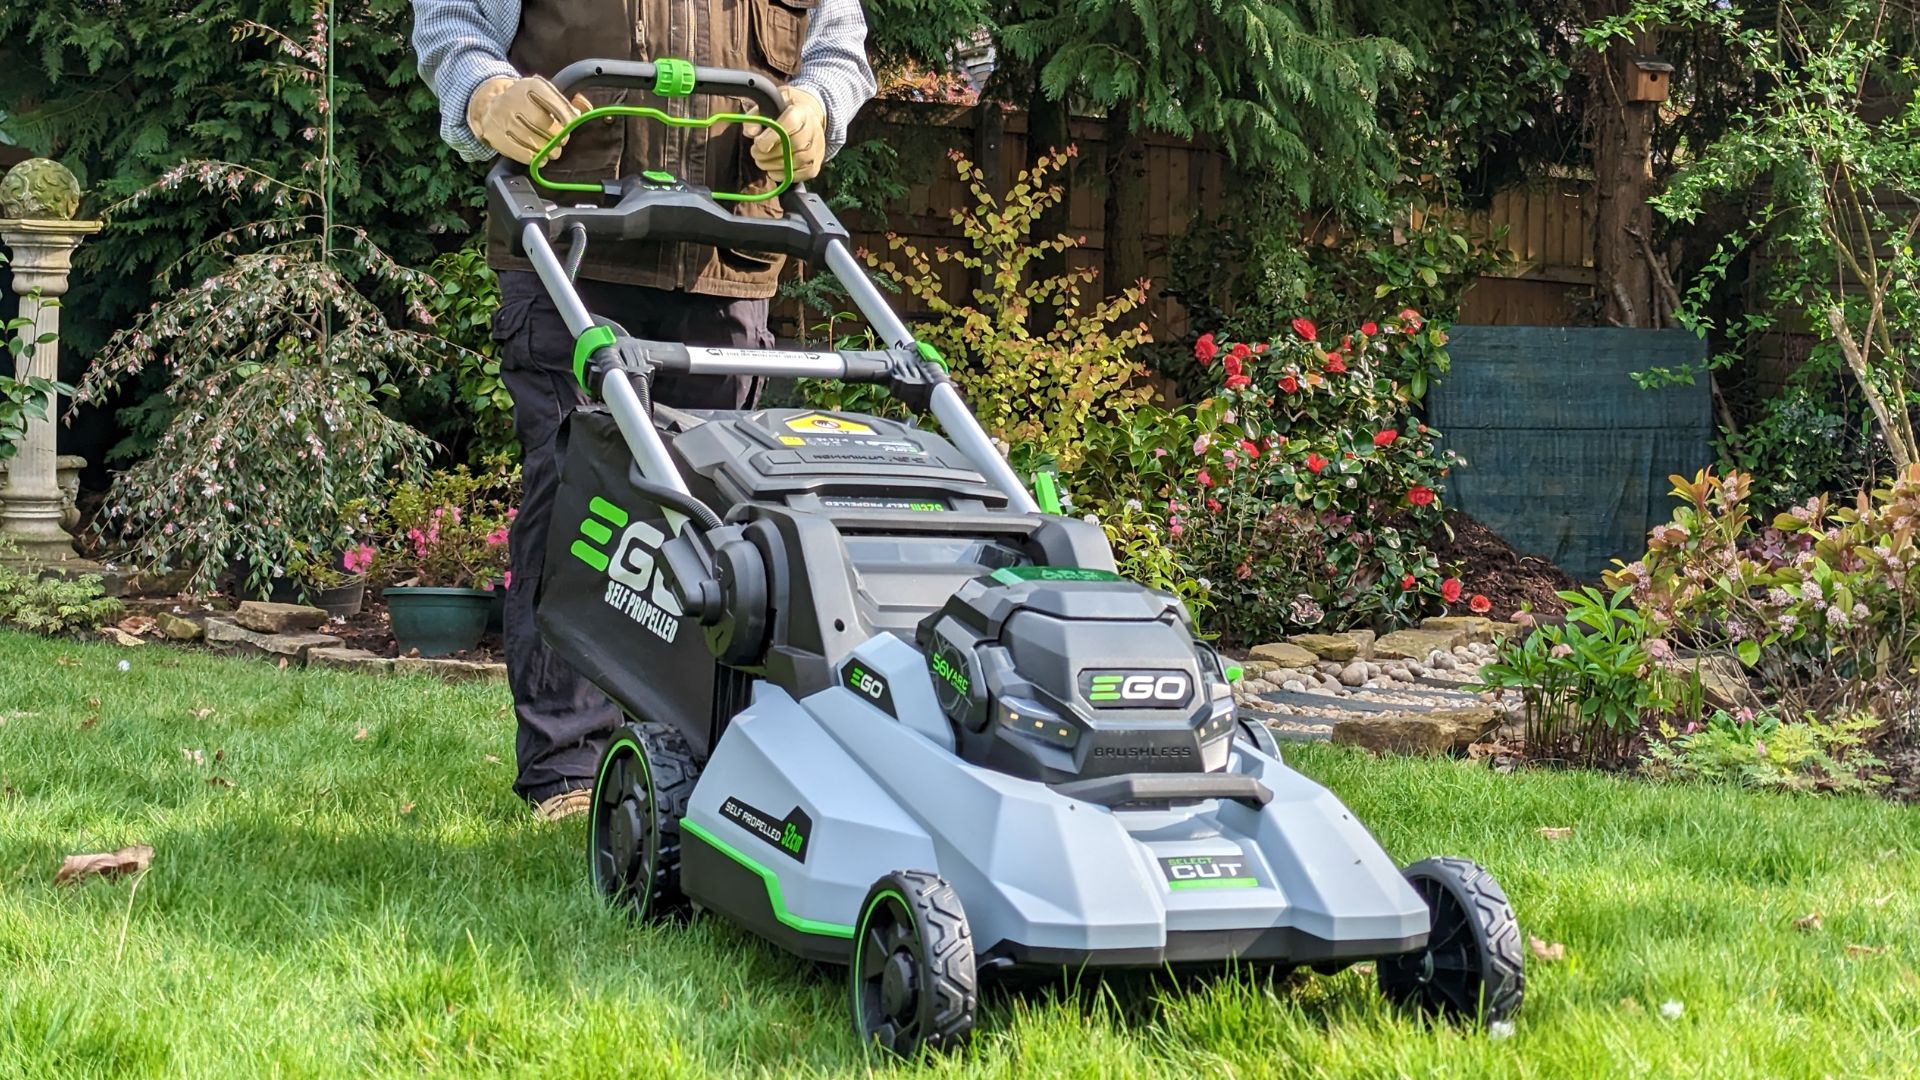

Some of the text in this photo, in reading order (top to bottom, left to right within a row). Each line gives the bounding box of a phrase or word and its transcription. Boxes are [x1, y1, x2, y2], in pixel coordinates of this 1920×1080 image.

[825, 501, 884, 509] PROPELLED
[604, 580, 679, 644] SELF PROPELLED
[850, 667, 884, 699] EGO
[932, 652, 954, 681] 56V
[952, 672, 969, 690] ARC
[1089, 675, 1187, 700] EGO
[1094, 746, 1192, 758] BRUSHLESS
[724, 801, 804, 854] SELF PROPELLED 52cm
[1167, 857, 1213, 866] SELECT
[1170, 863, 1242, 879] CUT
